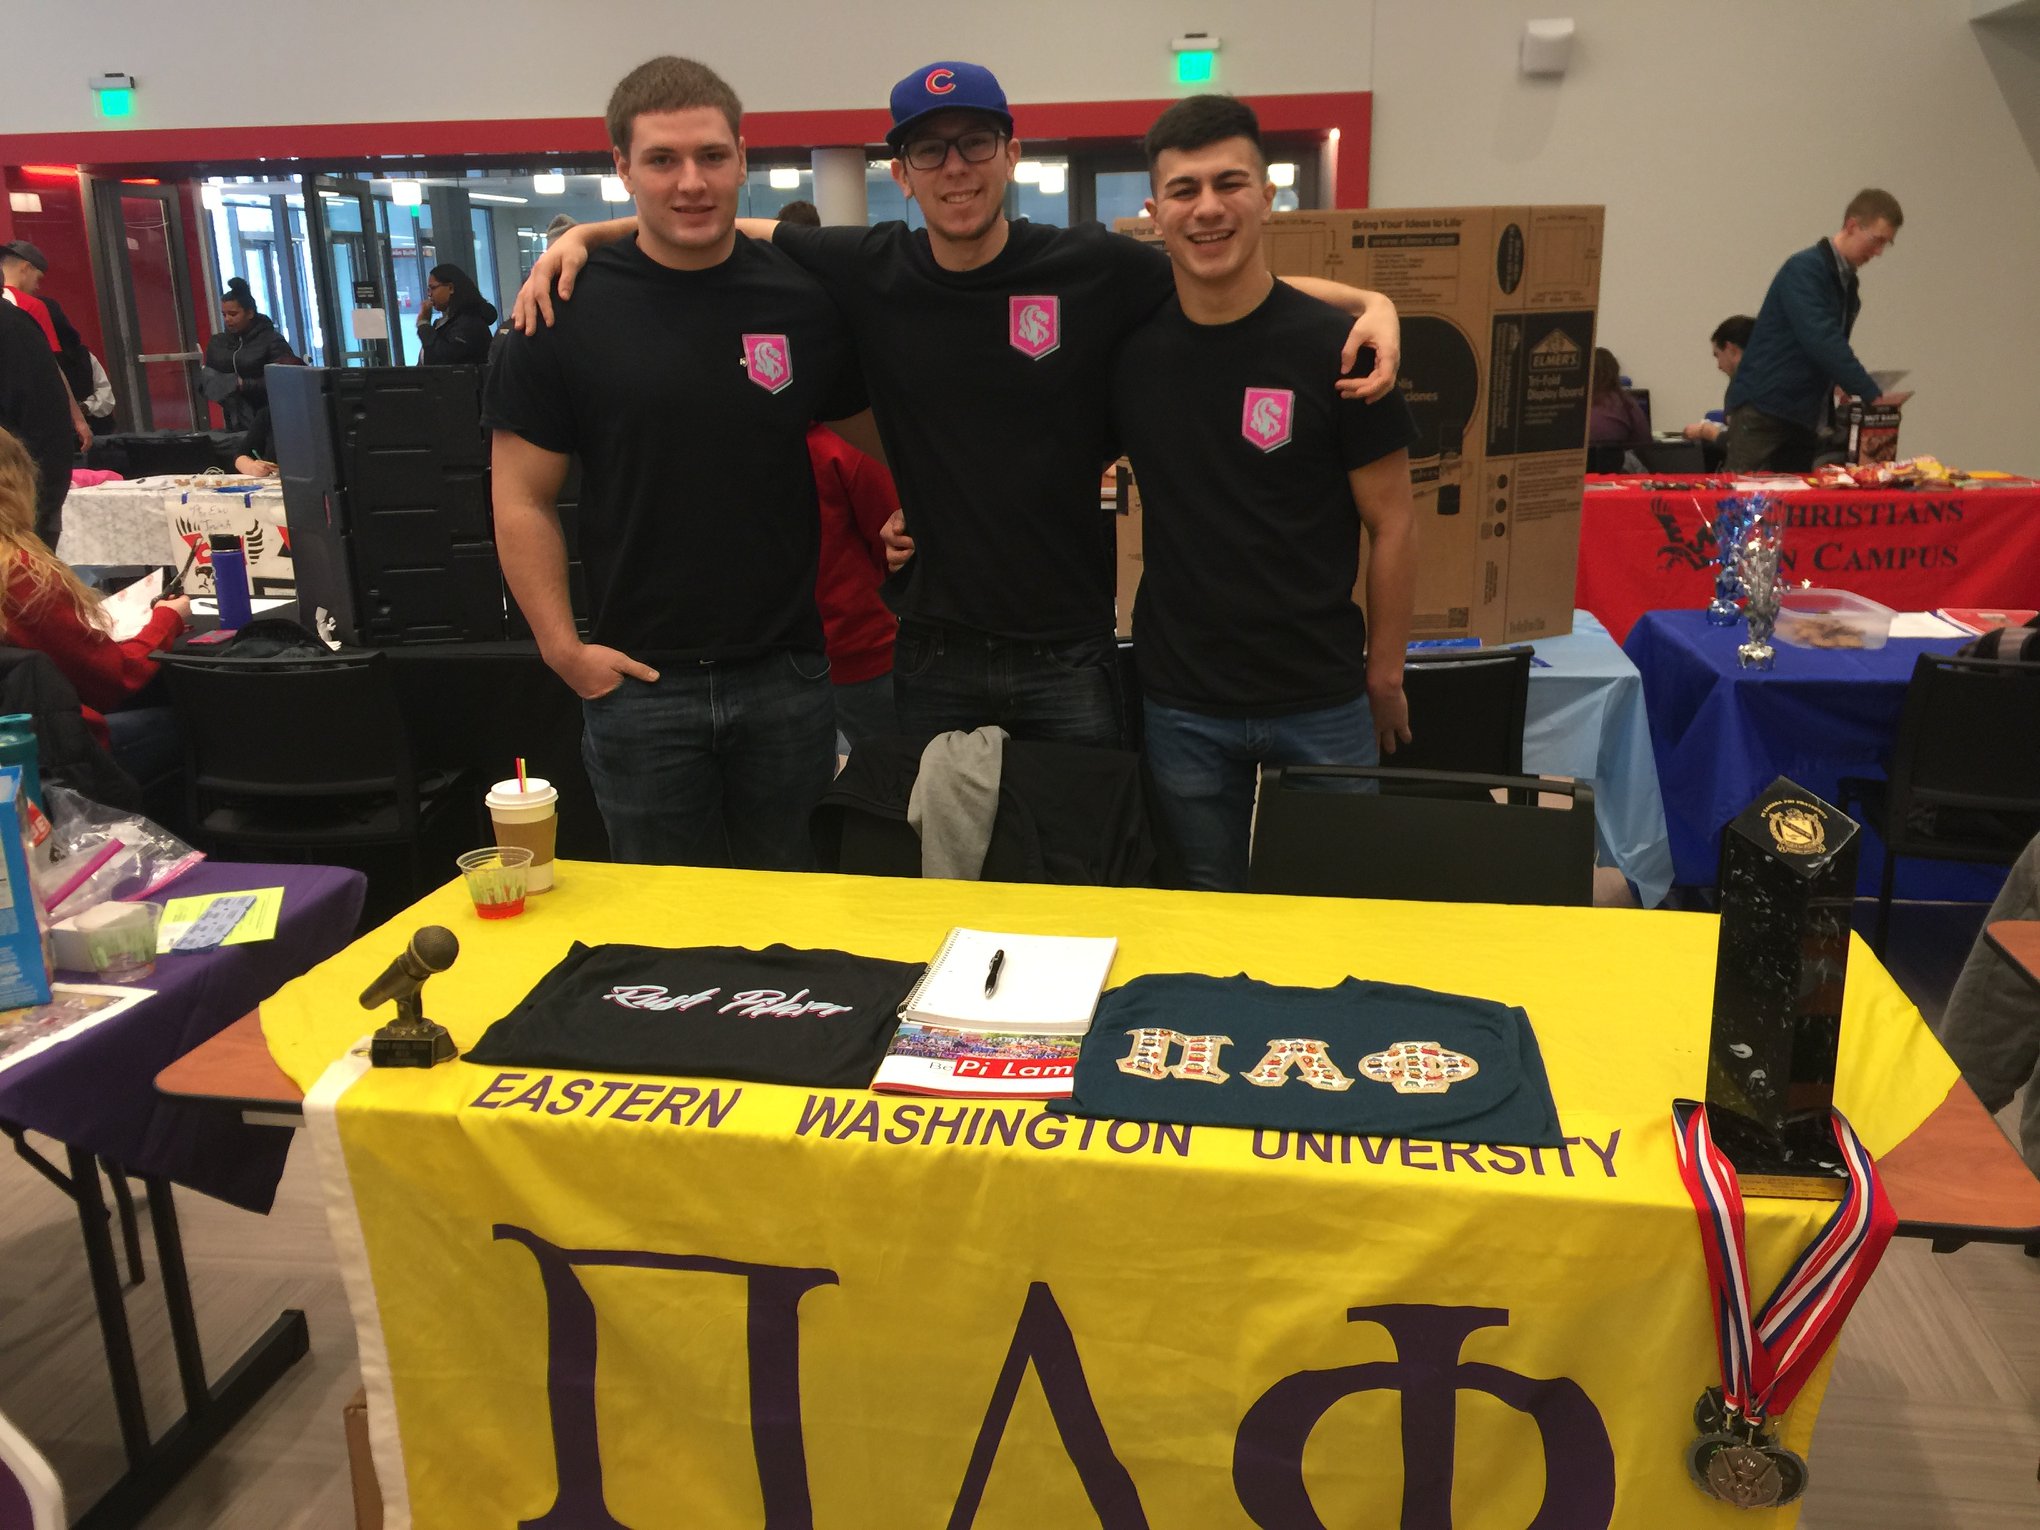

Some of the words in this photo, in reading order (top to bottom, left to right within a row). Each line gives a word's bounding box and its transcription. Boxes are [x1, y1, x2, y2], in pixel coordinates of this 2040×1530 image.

[925, 68, 957, 95] C
[1381, 219, 1403, 228] Your
[1405, 219, 1431, 228] Ideas
[1813, 542, 1959, 572] CAMPUS
[602, 984, 721, 1012] Rush
[956, 1060, 990, 1075] Pi
[1002, 1062, 1073, 1077] Lam
[469, 1072, 742, 1128] EASTERN
[795, 1093, 1192, 1157] WASHINGTON
[1251, 1126, 1622, 1179] UNIVERSITY
